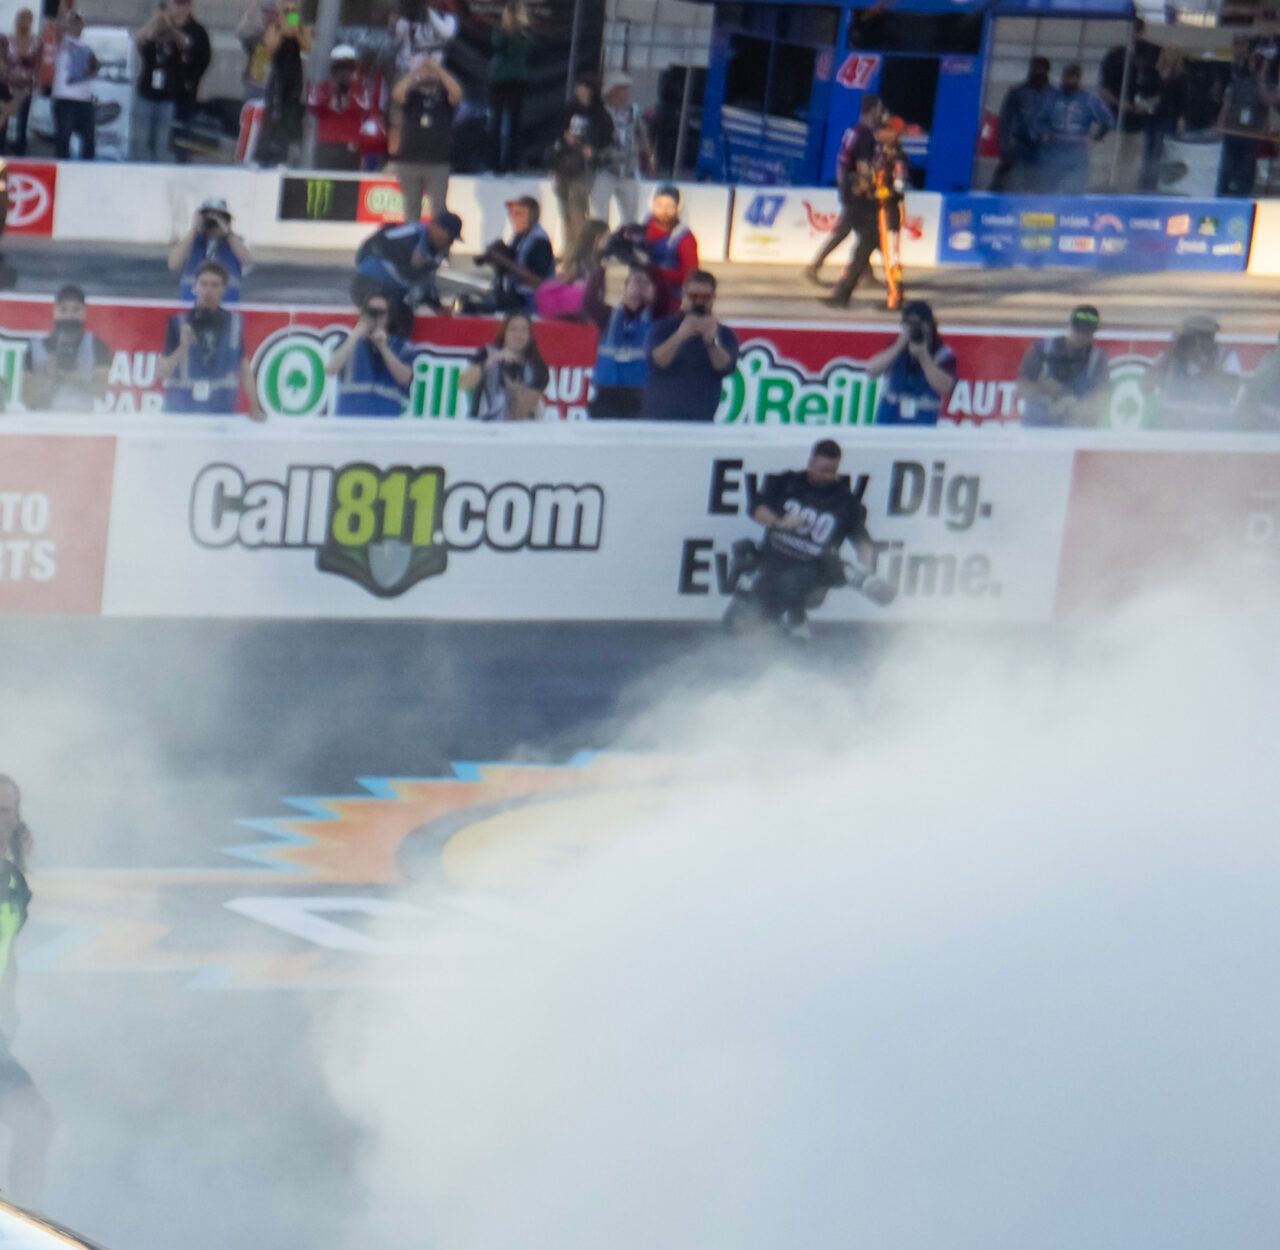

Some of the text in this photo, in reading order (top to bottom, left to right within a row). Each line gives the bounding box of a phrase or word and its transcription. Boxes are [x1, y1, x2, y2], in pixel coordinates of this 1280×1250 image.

[946, 380, 1025, 417] AUT
[190, 462, 605, 549] Call811.com
[886, 460, 993, 533] Dig.
